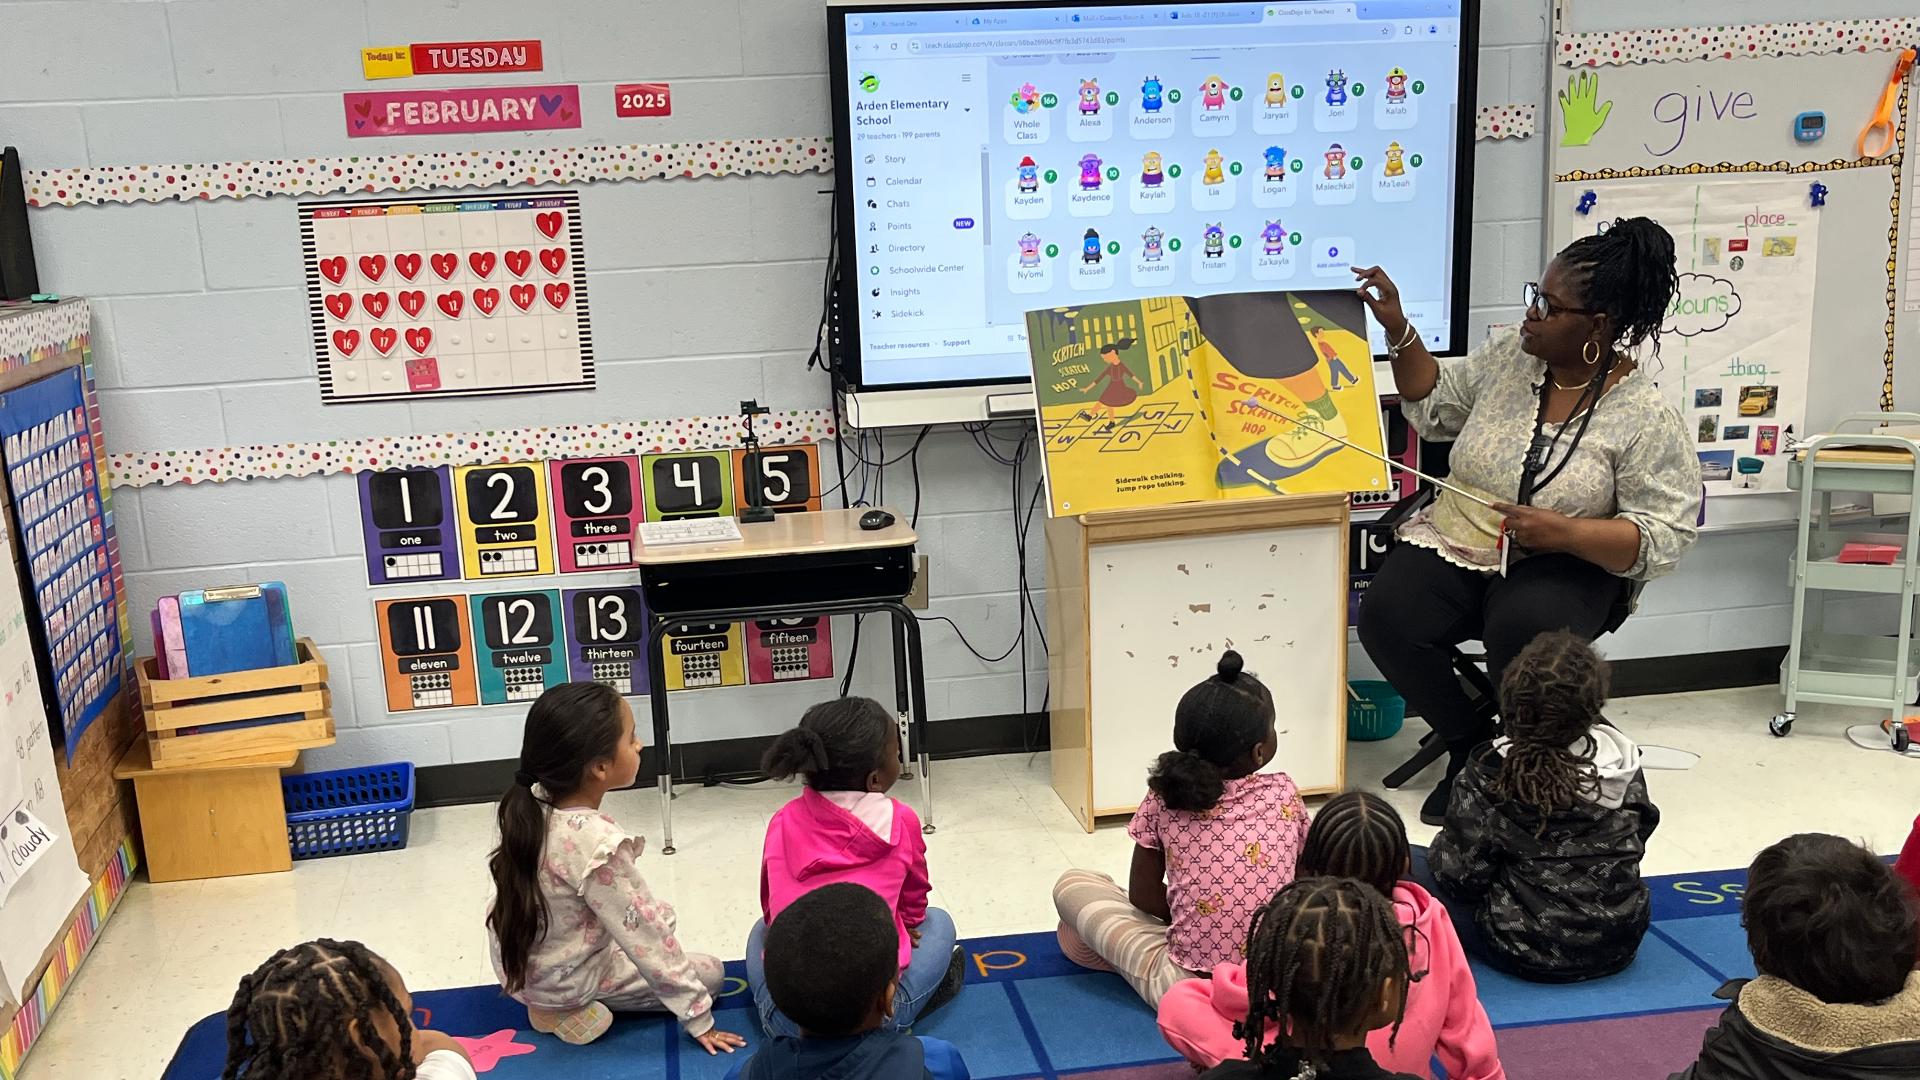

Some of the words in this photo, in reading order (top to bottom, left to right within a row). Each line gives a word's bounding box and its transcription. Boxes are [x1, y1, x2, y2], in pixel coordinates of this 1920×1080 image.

[366, 52, 393, 62] Today
[428, 46, 527, 69] TUESDAY
[1294, 88, 1300, 96] 11
[1355, 85, 1361, 93] 7
[1415, 84, 1421, 92] 7
[1234, 90, 1239, 98] 9
[621, 94, 666, 109] 2025
[856, 100, 888, 111] Arden
[890, 99, 949, 111] Elementary
[1043, 96, 1055, 105] 166
[386, 98, 537, 126] FEBRUARY
[856, 115, 891, 126] School
[1013, 120, 1040, 129] Whole
[1079, 118, 1101, 127] Alexa
[1134, 115, 1172, 125] Anderson
[1644, 85, 1757, 156] give
[902, 131, 913, 139] 199
[915, 130, 940, 139] parents
[1016, 131, 1037, 140] Class
[884, 154, 906, 165] Story
[1354, 159, 1359, 167] 7
[1413, 157, 1419, 165] 11
[1172, 167, 1178, 175] 9
[1233, 165, 1239, 173] 11
[1292, 162, 1301, 170] 10
[886, 177, 922, 186] Calendar
[1048, 173, 1054, 181] 7
[1140, 190, 1166, 200] Kaylah
[1208, 188, 1220, 196] Lia
[1263, 185, 1287, 195] Logan
[1014, 196, 1044, 206] Kayden
[1072, 194, 1111, 203] Kaydence
[505, 201, 521, 209] FRIDAY
[535, 199, 560, 207] SATURDAY
[887, 200, 910, 208] Chats
[549, 221, 553, 231] 1
[1745, 206, 1785, 236] place
[887, 222, 912, 231] Points
[1233, 237, 1238, 246] 9
[888, 243, 925, 253] Directory
[1049, 246, 1055, 255] 9
[1111, 244, 1117, 252] 9
[333, 266, 339, 276] 2
[372, 264, 378, 274] 3
[406, 263, 412, 273] 4
[443, 262, 449, 273] 5
[481, 261, 487, 271] 6
[516, 259, 522, 270] 7
[551, 257, 558, 268] 8
[889, 264, 936, 274] Schoolwide
[937, 263, 964, 273] Center
[1201, 261, 1226, 269] Tristan
[1017, 270, 1043, 280] Ny'omi
[1079, 267, 1106, 276] Russell
[890, 288, 921, 297] Insights
[337, 302, 343, 312] 9
[373, 301, 383, 312] 10
[409, 299, 416, 310] 11
[449, 301, 458, 311] 12
[483, 297, 493, 307] 13
[519, 293, 528, 303] 14
[554, 292, 563, 303] 15
[891, 309, 924, 318] Sidekick
[342, 338, 352, 349] 16
[380, 337, 388, 347] 17
[415, 337, 425, 347] 18
[943, 339, 970, 348] Support
[1052, 343, 1085, 366] SCRITCH
[1058, 364, 1090, 378] SCRATCH
[1728, 357, 1768, 384] thing
[1051, 379, 1077, 393] HOP
[1212, 372, 1299, 410] SCRITCH
[1241, 422, 1266, 435] HOP
[673, 461, 702, 506] 4
[762, 455, 790, 502] 5
[1115, 476, 1148, 484] Sidewalk
[581, 466, 613, 514] 3
[1116, 484, 1136, 493] Jump
[1157, 480, 1185, 489] talking.
[400, 477, 413, 523] 1
[487, 472, 518, 519] 2
[584, 523, 617, 534] three
[400, 537, 422, 545] one
[494, 531, 518, 541] two
[498, 599, 539, 645] 12
[588, 595, 628, 641] 13
[413, 606, 435, 650] 11
[769, 633, 809, 643] fifteen
[675, 639, 725, 651] fourteen
[503, 653, 541, 664] twelve
[587, 648, 633, 659] thirteen
[410, 659, 447, 670] eleven
